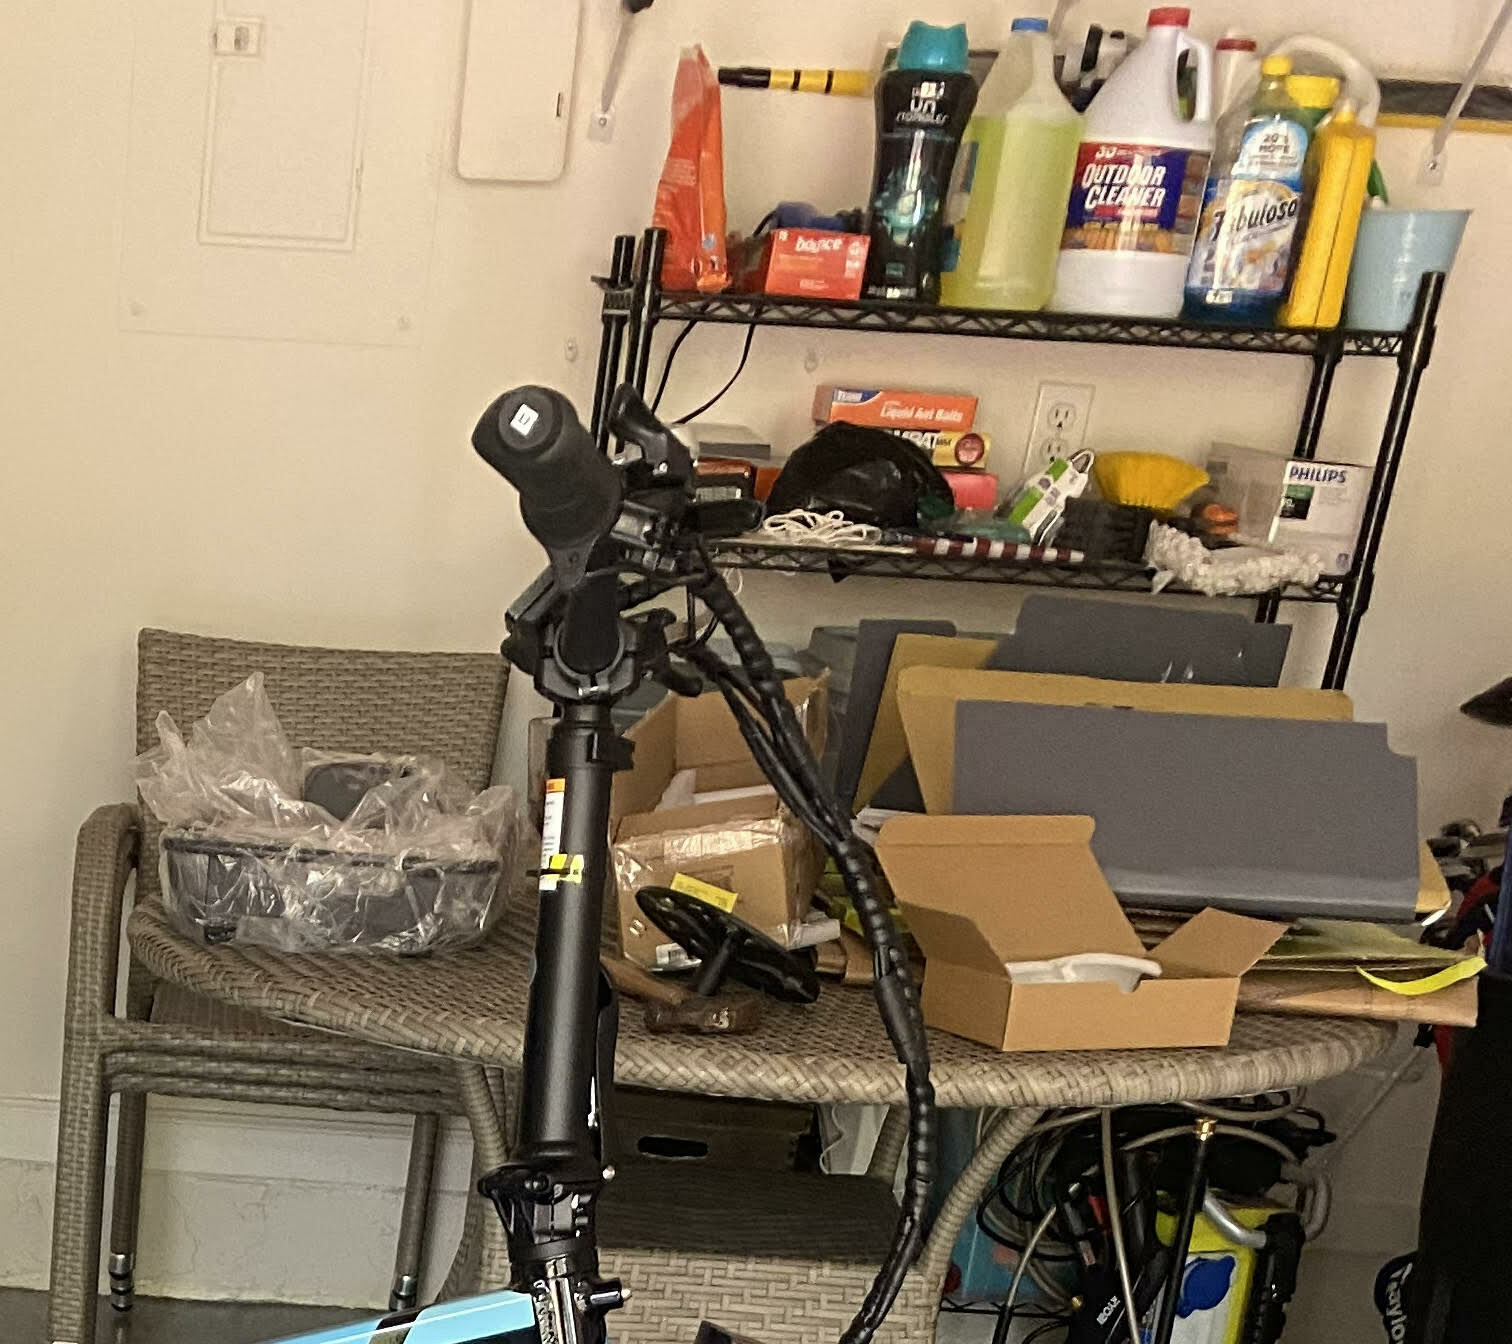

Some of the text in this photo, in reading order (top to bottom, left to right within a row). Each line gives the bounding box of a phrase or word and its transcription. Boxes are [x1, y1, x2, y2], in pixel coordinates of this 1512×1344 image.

[1081, 163, 1167, 190] OUTDOOR
[1084, 186, 1166, 210] CLEANER
[1212, 198, 1299, 242] Fbuloso
[880, 403, 966, 423] Liquid Ant Baits
[1289, 466, 1347, 484] PHILIPS
